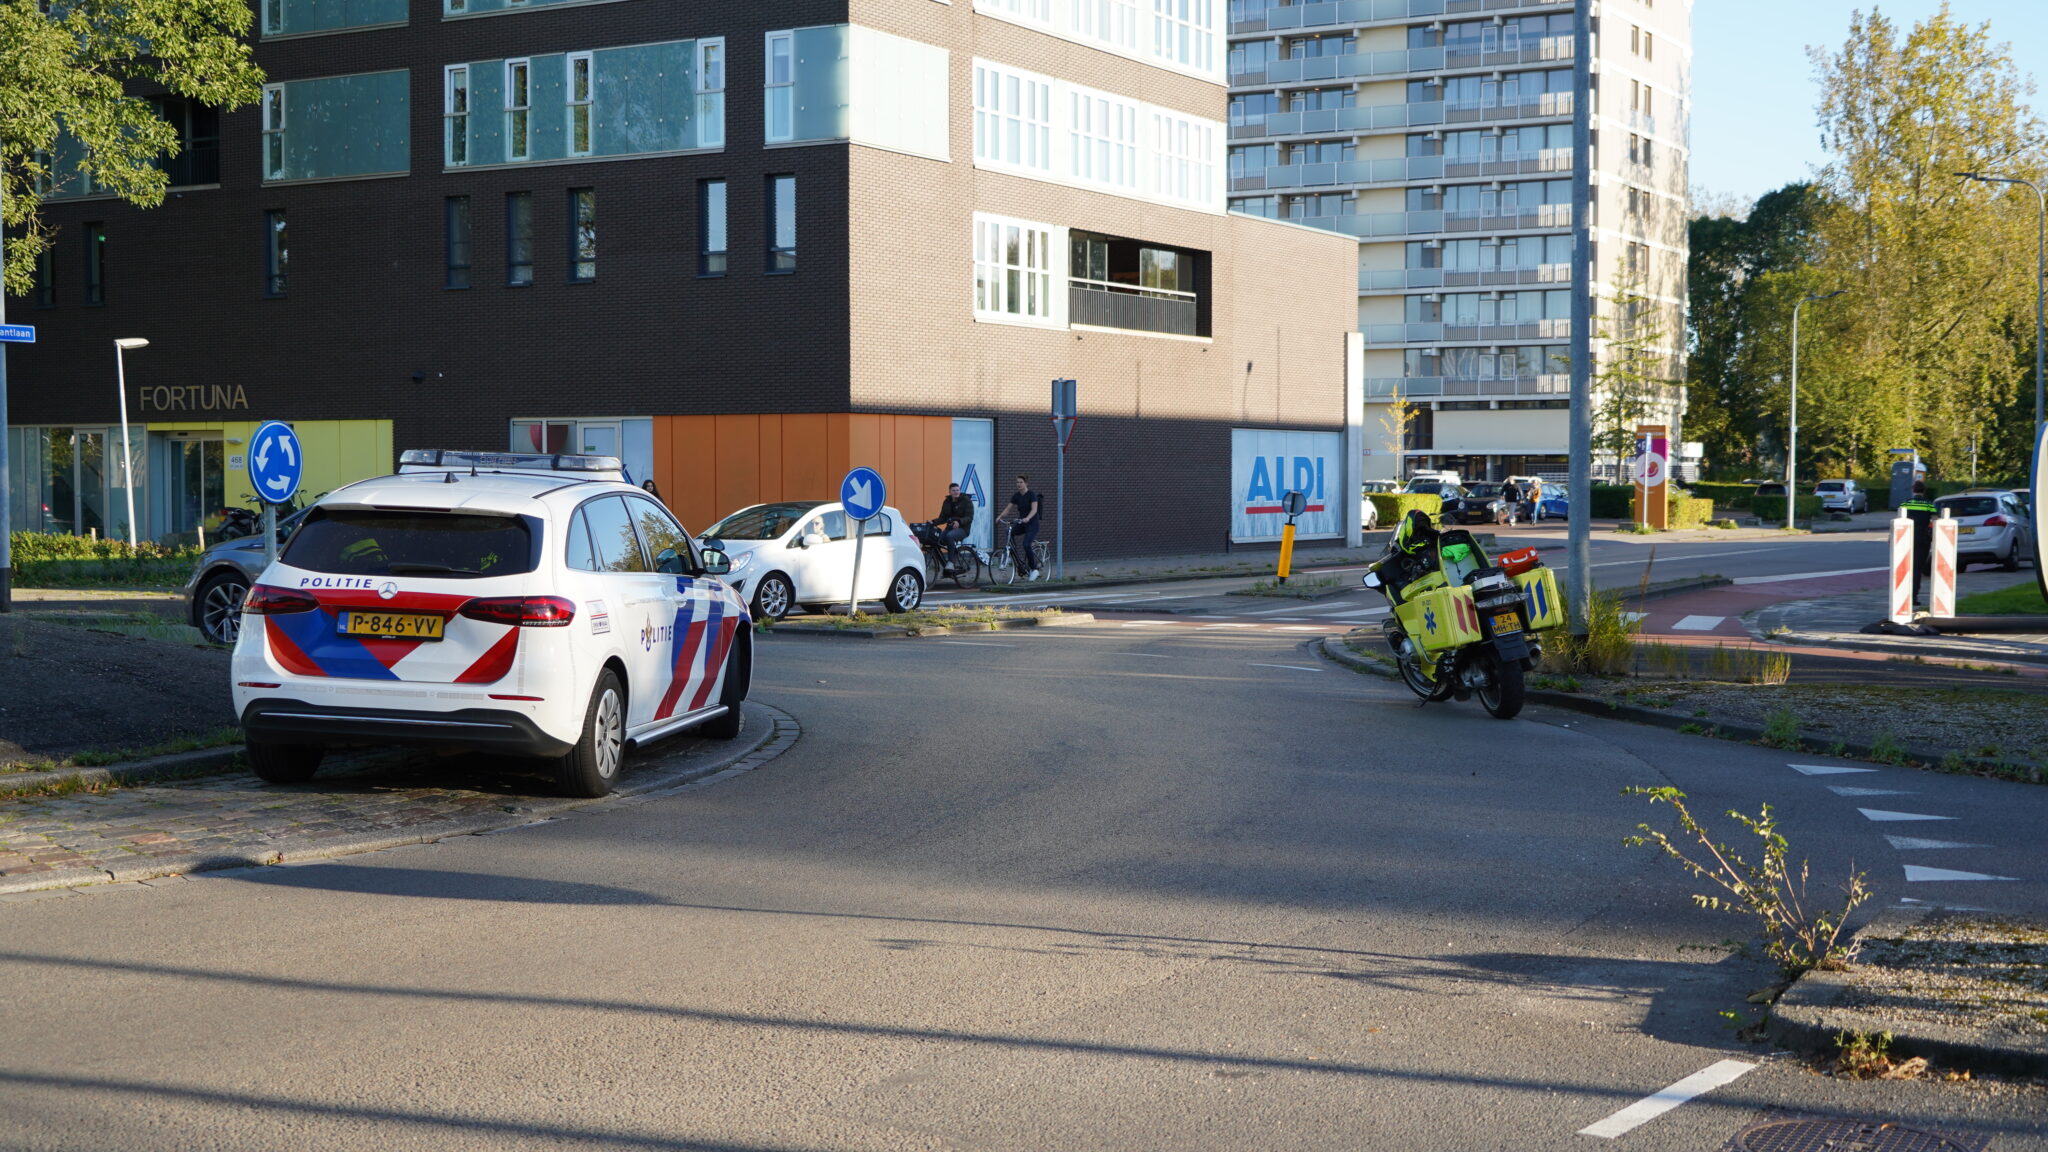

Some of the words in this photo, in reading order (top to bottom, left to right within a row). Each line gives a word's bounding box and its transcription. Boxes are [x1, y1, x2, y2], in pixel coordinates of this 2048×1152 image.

[140, 384, 249, 411] FORTUNA
[1247, 456, 1324, 501] ALDI
[300, 577, 373, 588] POLITIE
[353, 615, 437, 634] P-846-VV
[1500, 615, 1512, 623] 24
